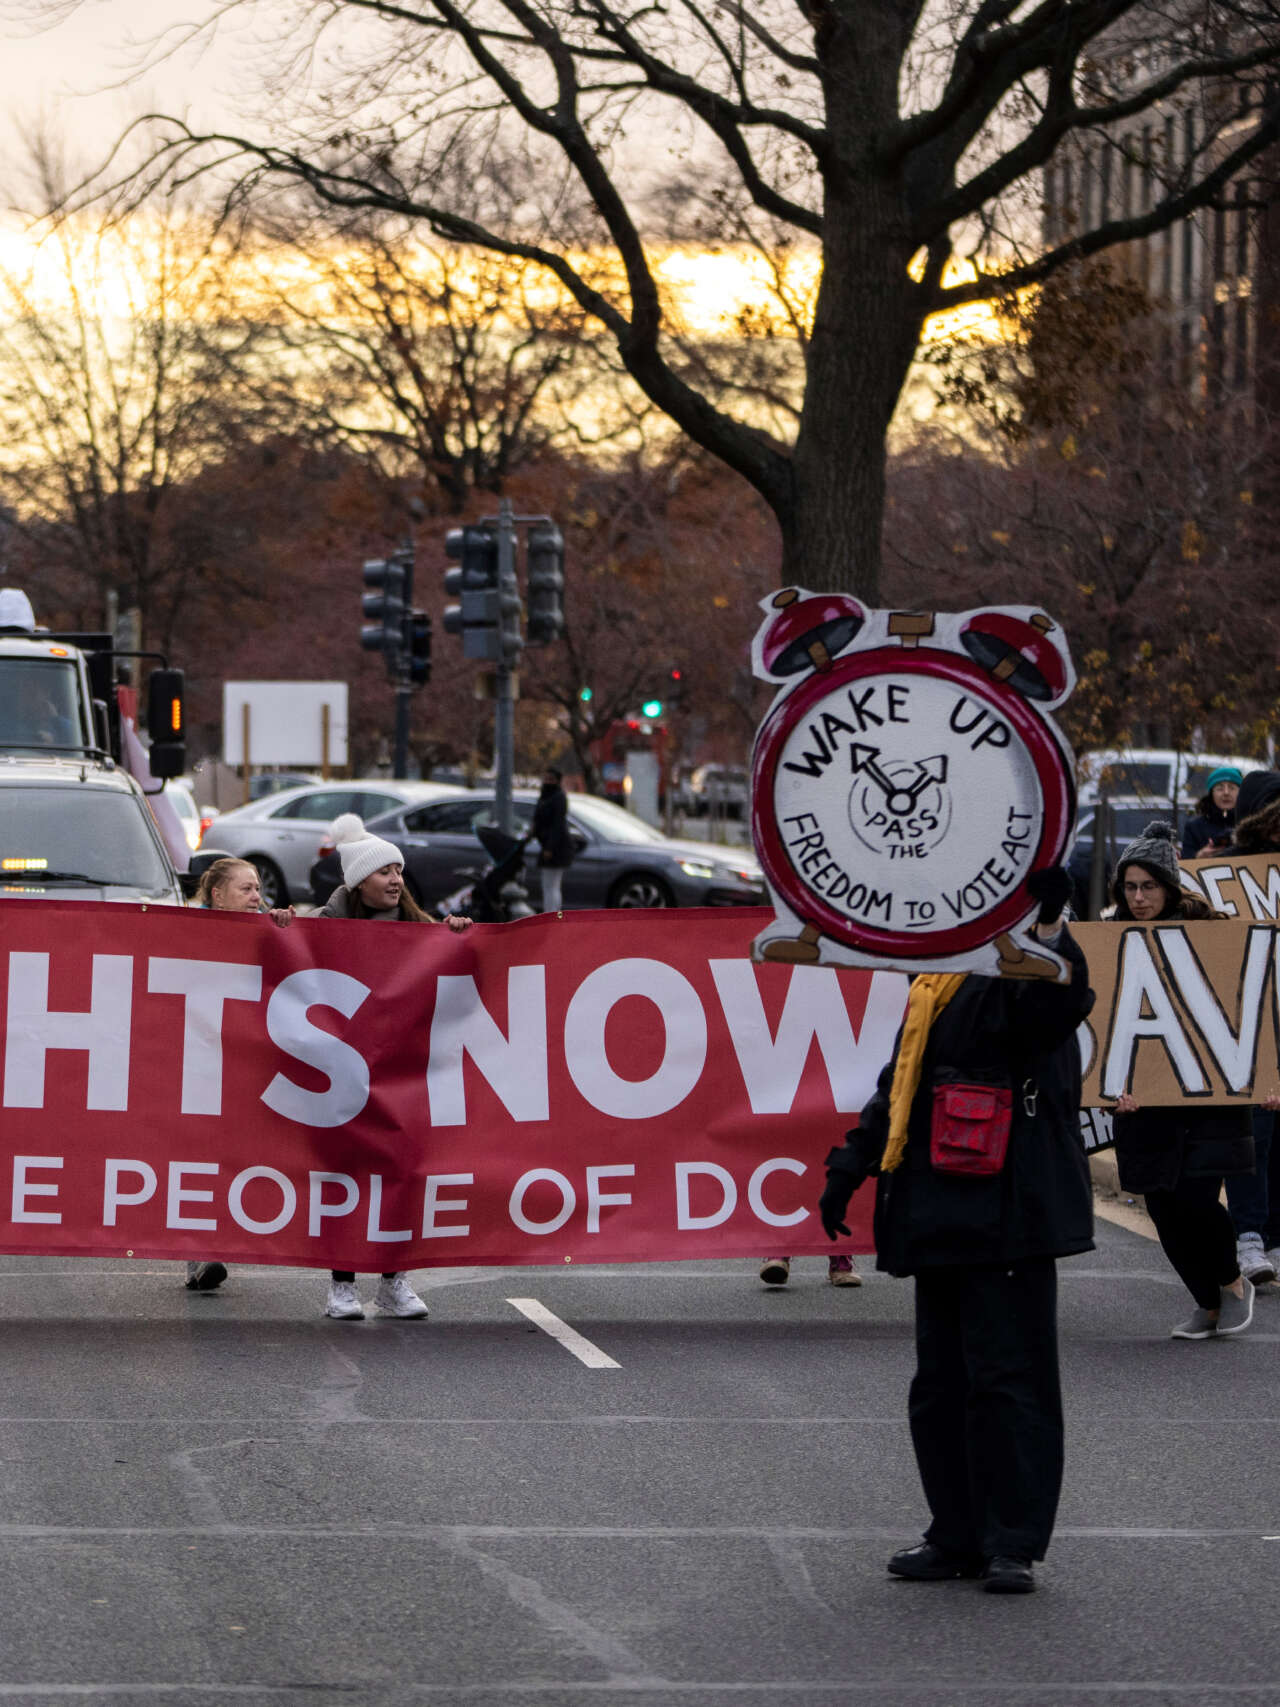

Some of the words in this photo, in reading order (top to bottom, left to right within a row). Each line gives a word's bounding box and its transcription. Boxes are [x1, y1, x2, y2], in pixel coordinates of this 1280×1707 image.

[783, 684, 910, 778] WAKE
[949, 696, 1012, 751] UP
[783, 812, 893, 922] FREEDOM
[904, 900, 936, 921] TO
[941, 857, 1015, 919] VOTE
[1001, 805, 1033, 867] ACT
[864, 809, 938, 840] PASS
[887, 842, 930, 860] THE
[426, 957, 909, 1128] NOW
[102, 1157, 474, 1243] PEOPLE
[509, 1163, 636, 1236] OF
[675, 1157, 811, 1231] DC
